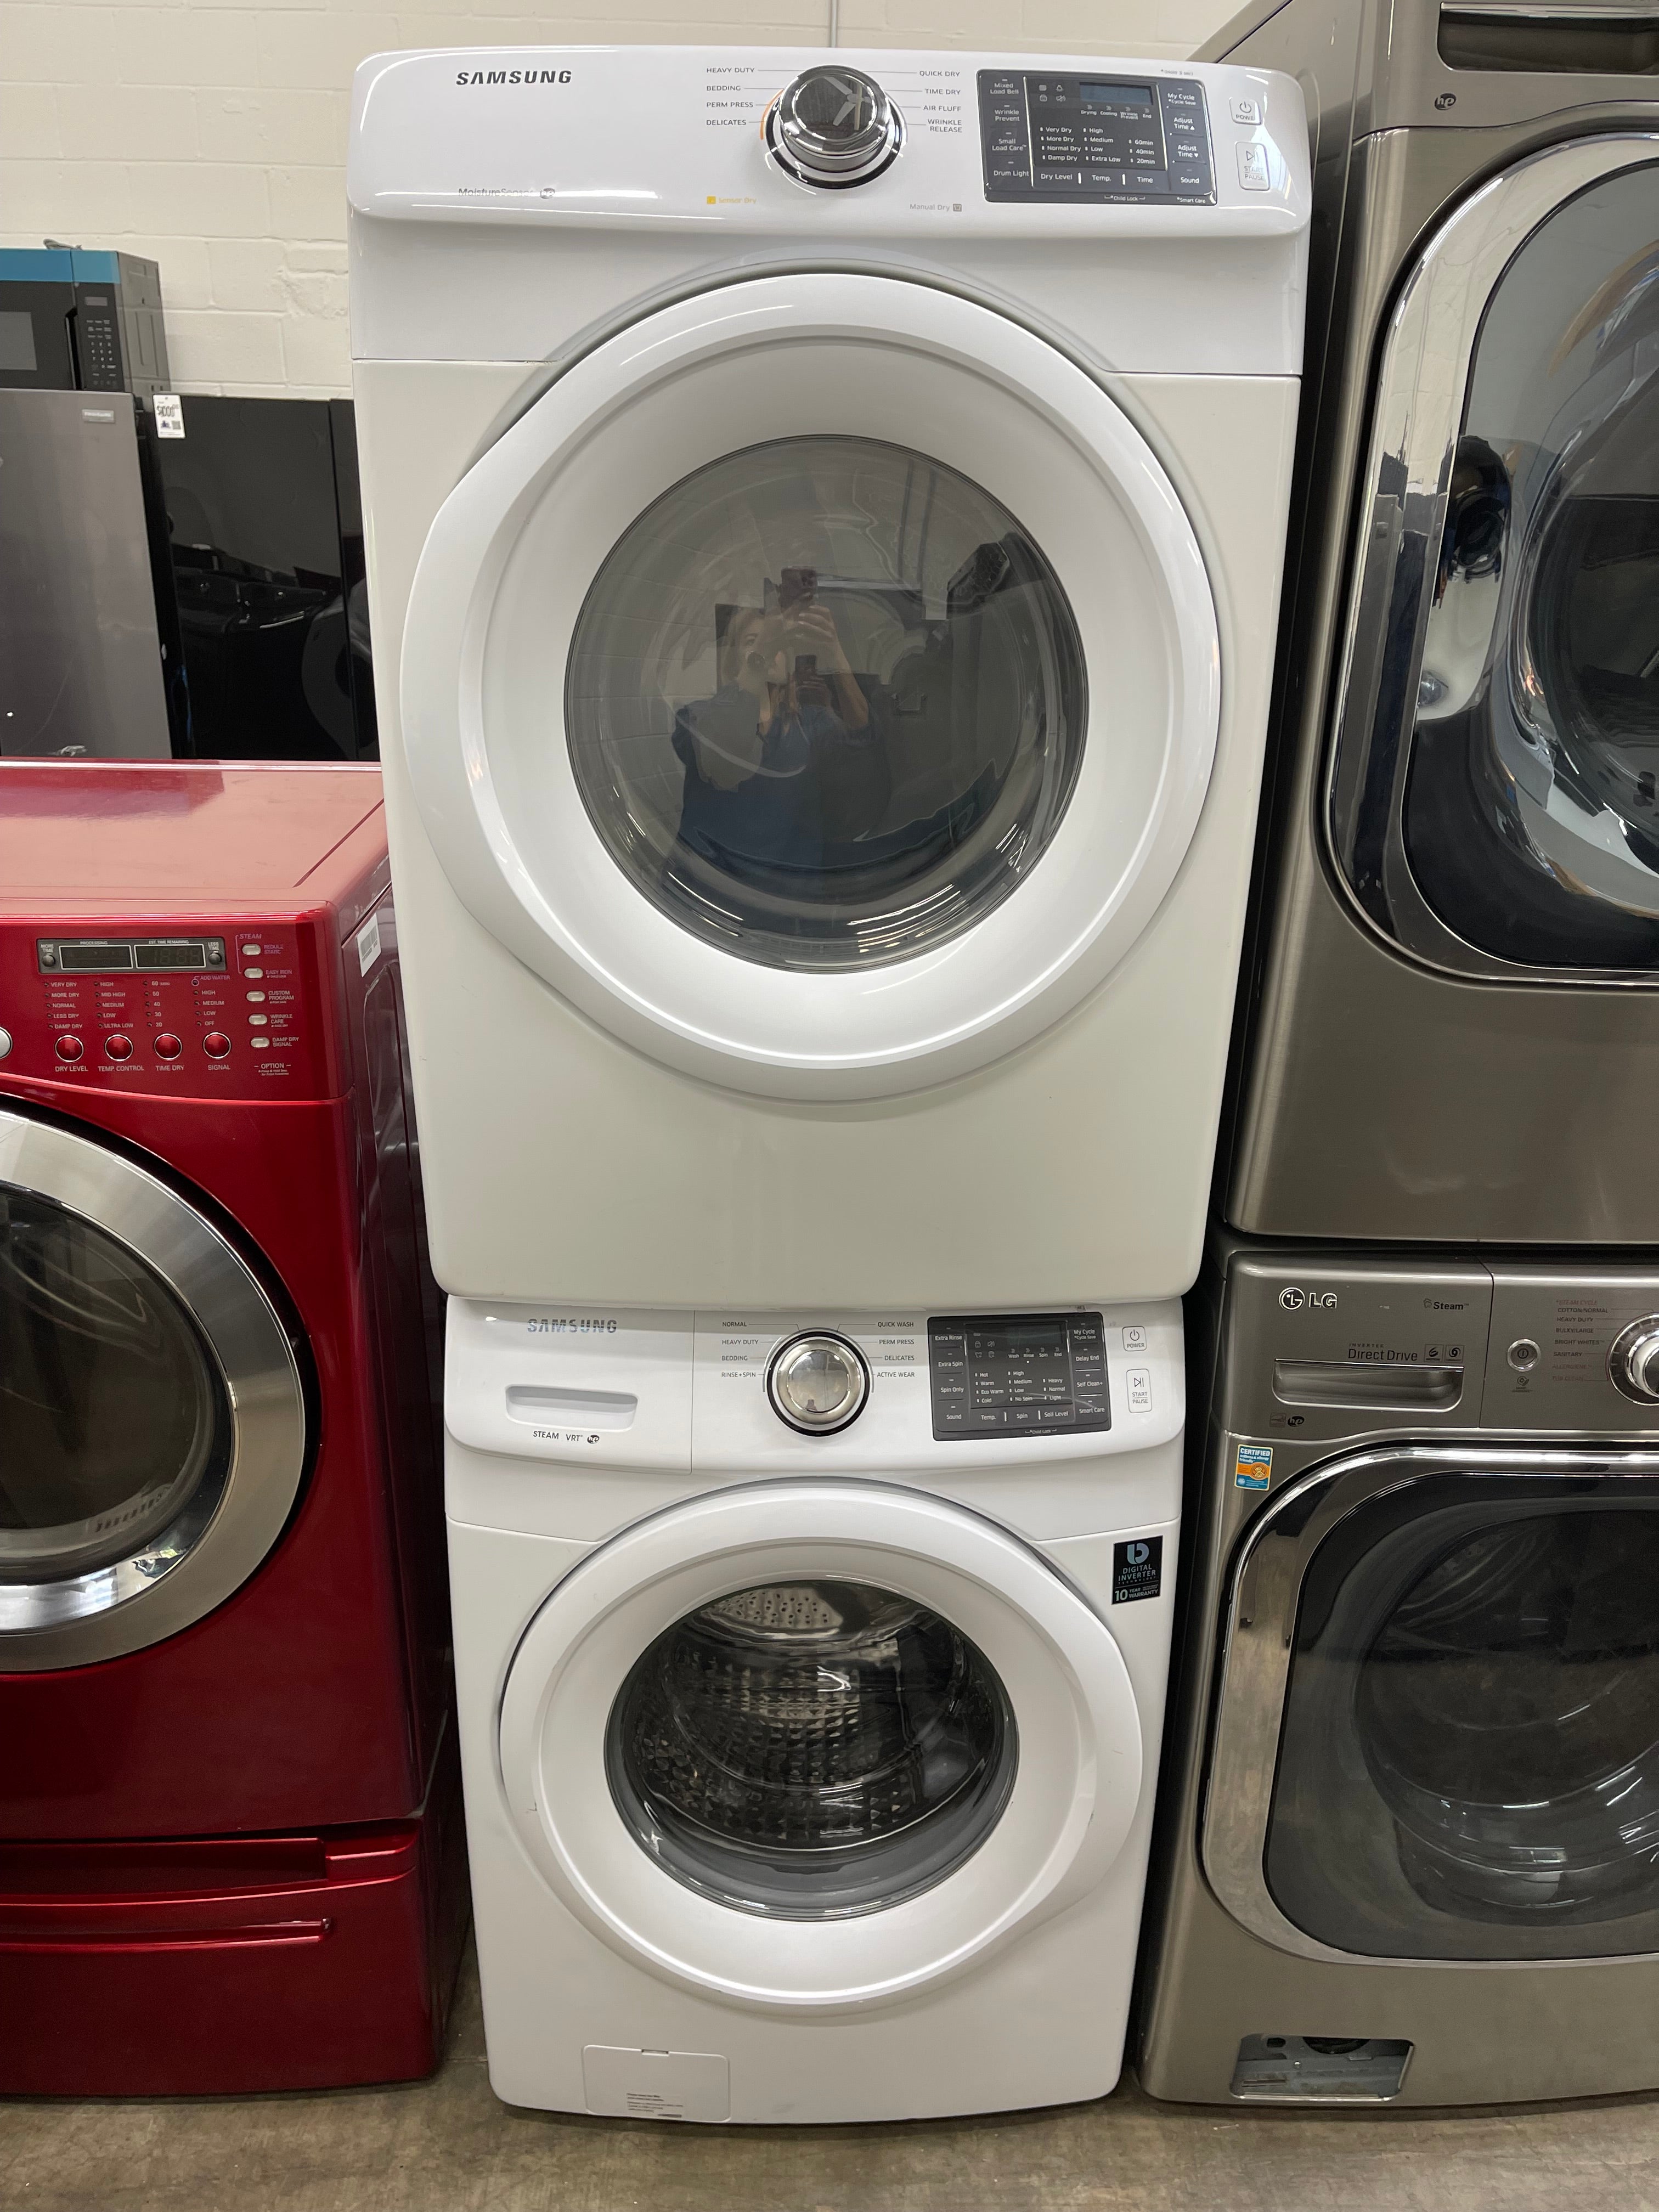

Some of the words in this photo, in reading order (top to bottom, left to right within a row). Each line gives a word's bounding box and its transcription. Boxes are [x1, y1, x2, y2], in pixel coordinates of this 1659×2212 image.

[456, 70, 572, 85] SAMSUNG
[1308, 1292, 1338, 1309] LG
[527, 1318, 617, 1333] SAMSUNG
[1348, 1348, 1385, 1361] Direct
[1387, 1350, 1418, 1361] Drive
[533, 1431, 559, 1439] STEAM
[1240, 1448, 1271, 1457] CERTIFIED
[1122, 1564, 1152, 1574] DIGITAL
[1118, 1570, 1156, 1581] INVERTER
[1115, 1589, 1128, 1601] 10
[1128, 1589, 1158, 1598] WARRANTY
